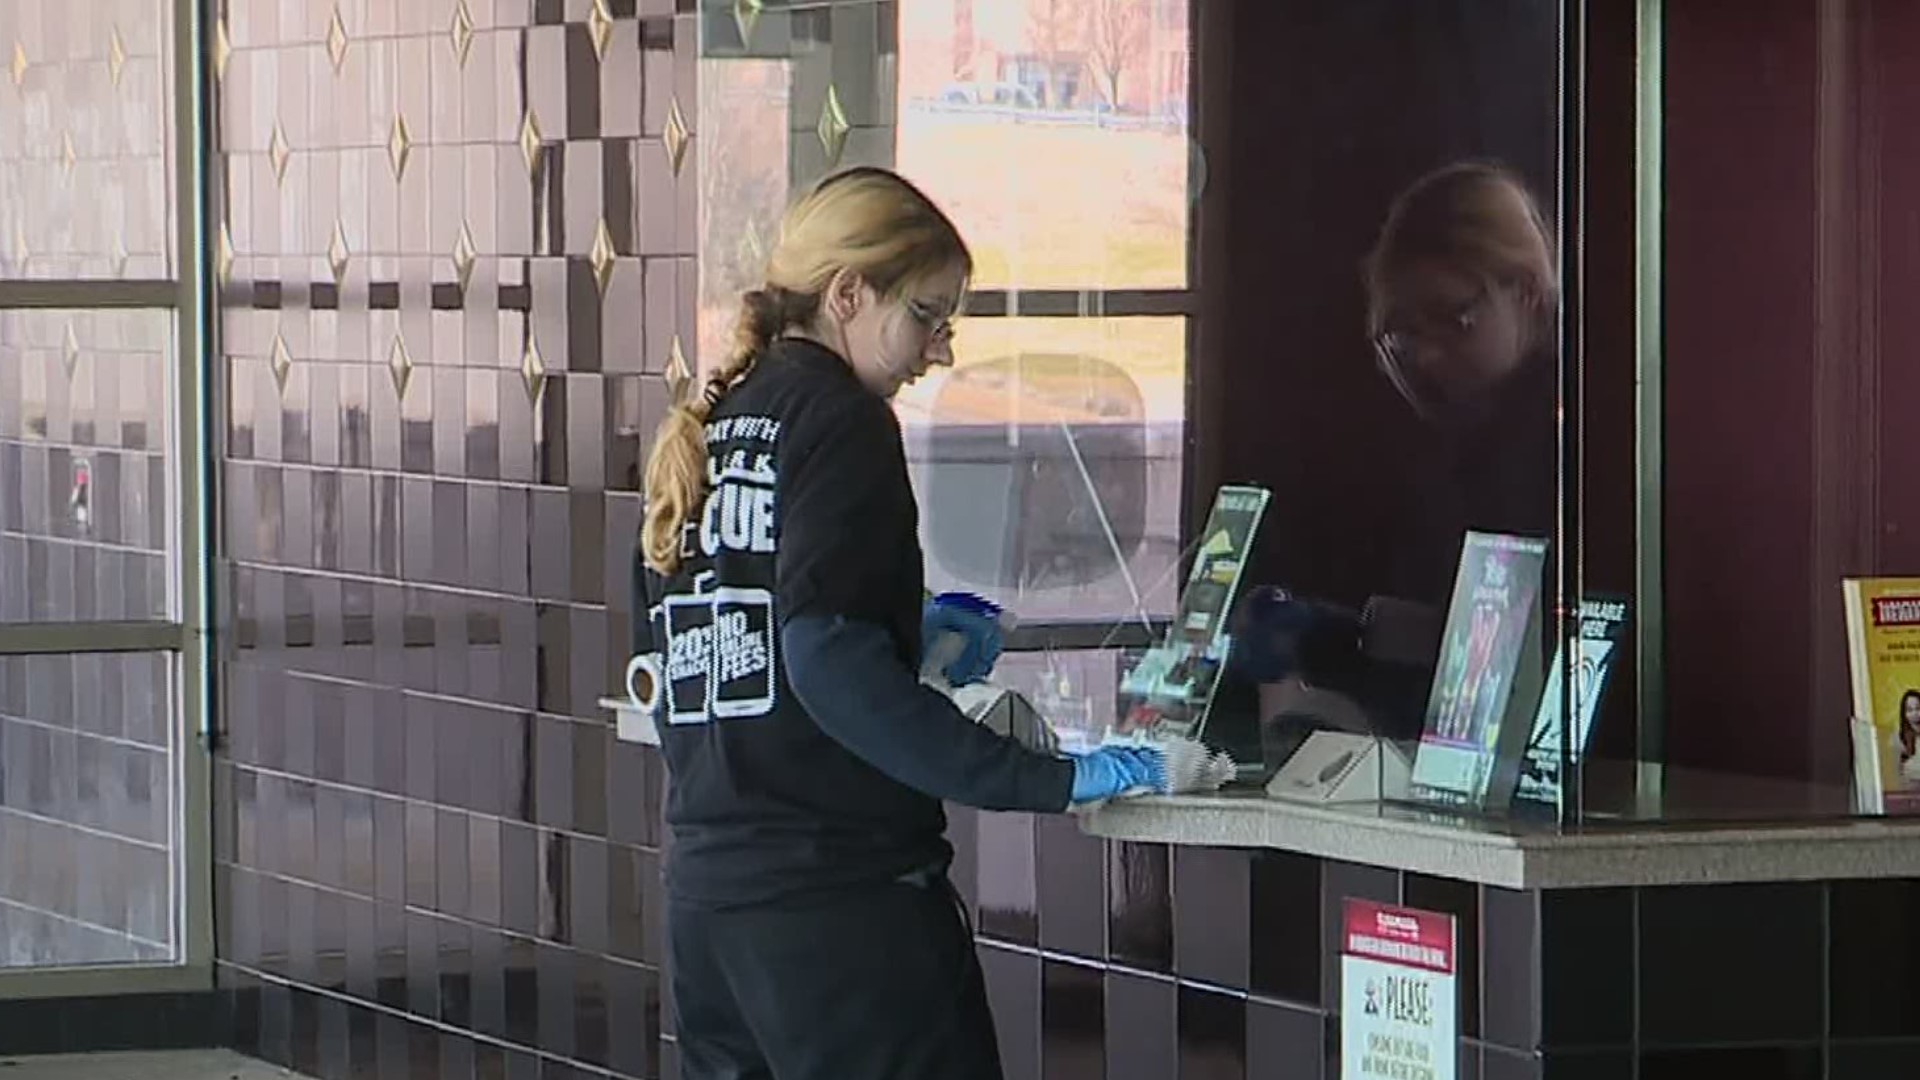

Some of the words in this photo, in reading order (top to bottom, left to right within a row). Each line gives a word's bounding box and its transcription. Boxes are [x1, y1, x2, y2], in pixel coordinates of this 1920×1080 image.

[733, 415, 781, 442] WITH
[719, 610, 747, 640] NO
[1571, 601, 1626, 621] VAILABLE
[721, 646, 767, 683] FEES
